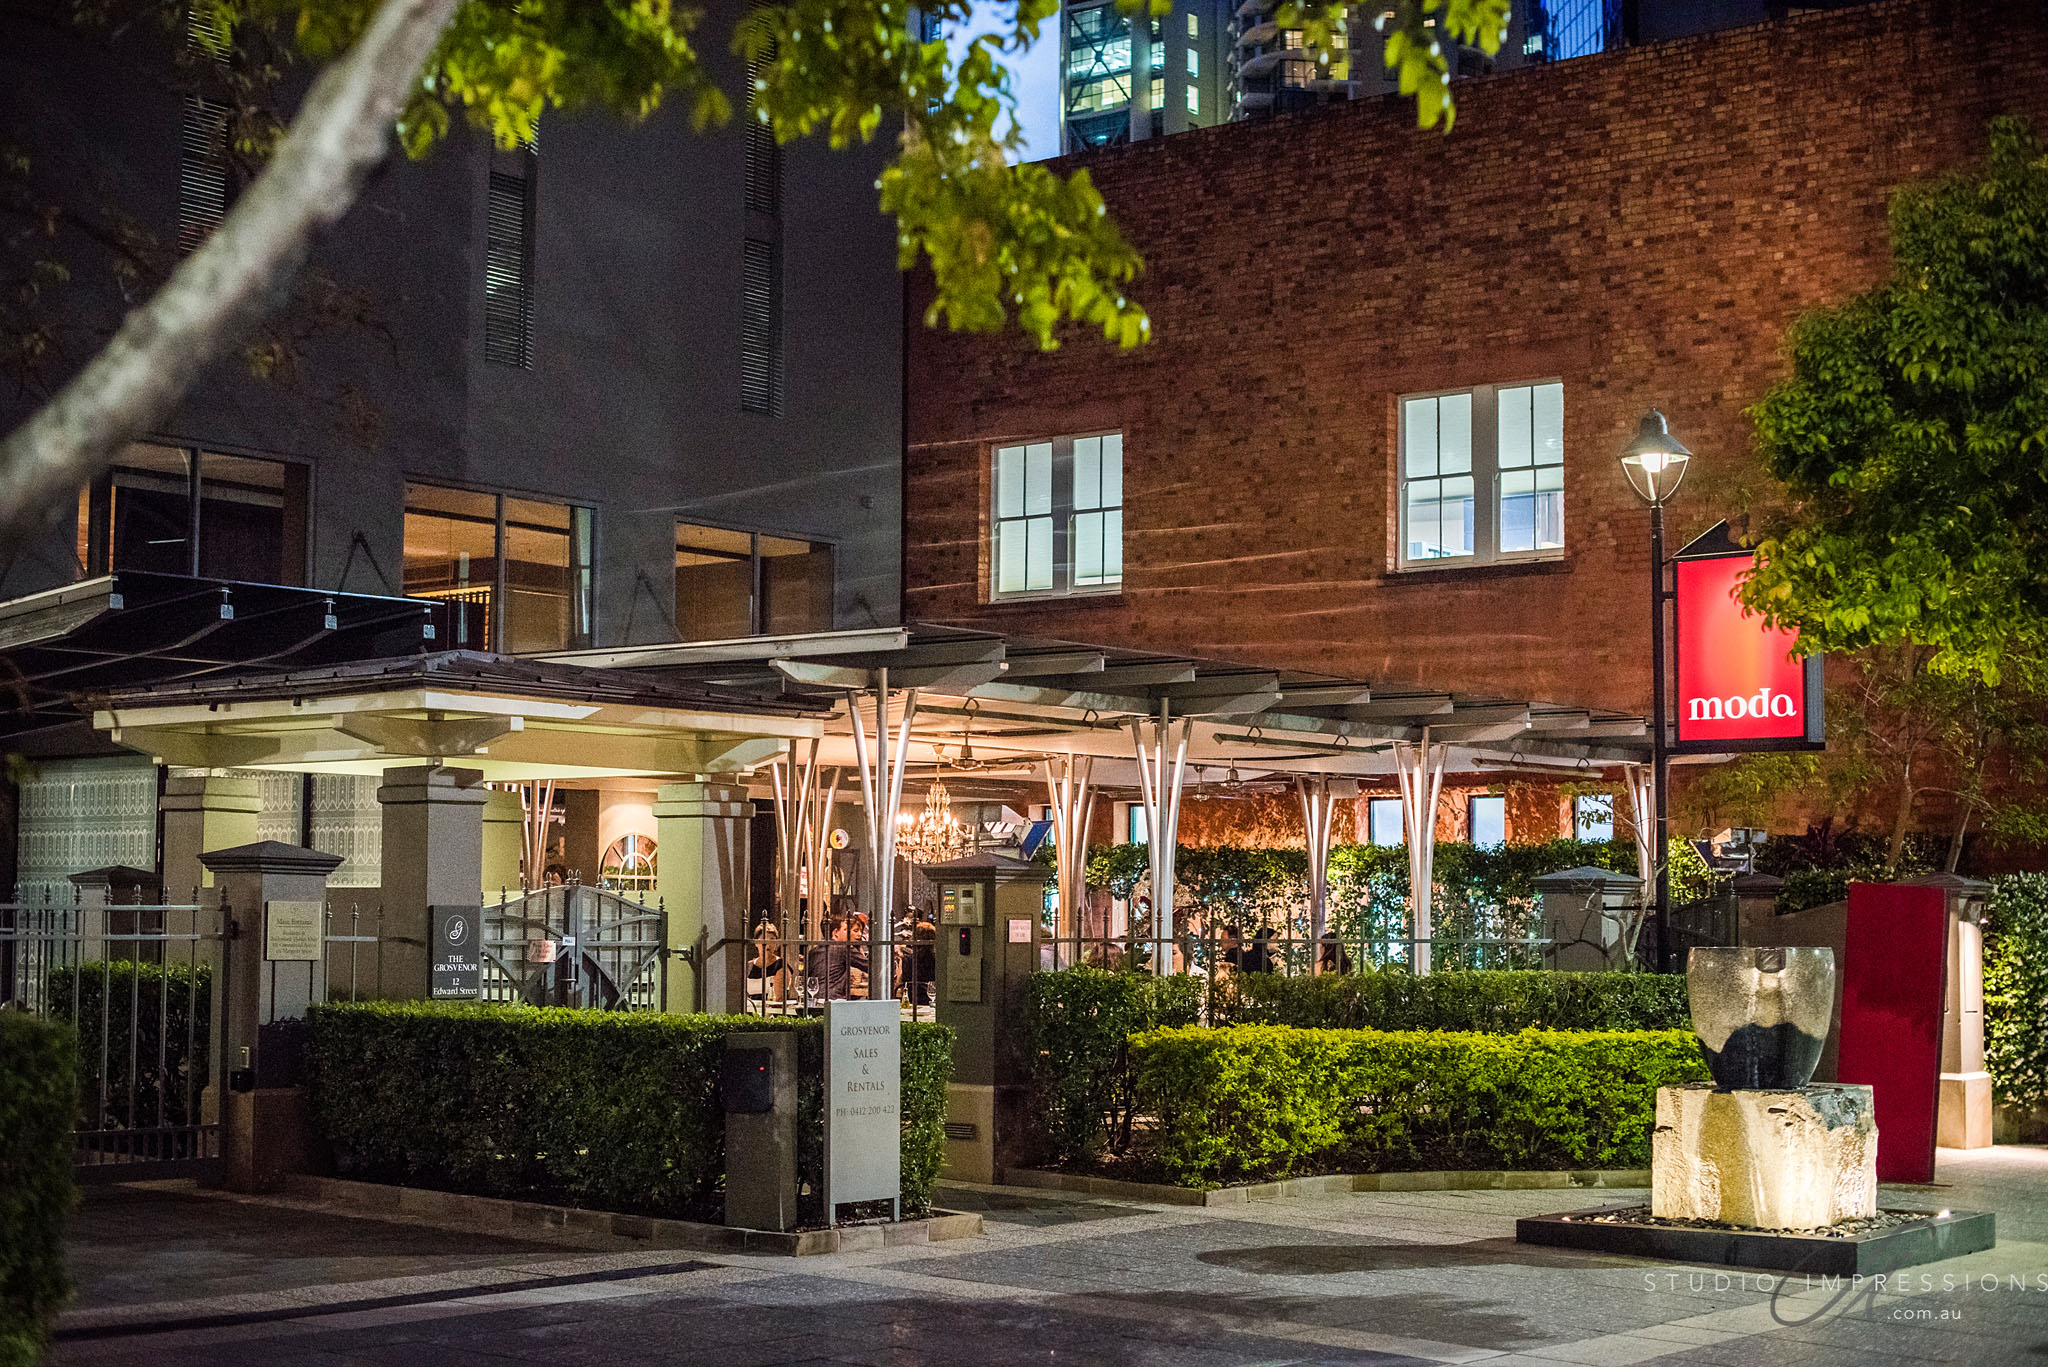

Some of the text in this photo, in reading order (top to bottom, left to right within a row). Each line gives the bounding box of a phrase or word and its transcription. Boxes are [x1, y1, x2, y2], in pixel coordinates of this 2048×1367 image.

[1688, 687, 1797, 720] moda
[447, 955, 464, 963] THE
[433, 963, 478, 972] GROSVENOR
[452, 977, 460, 986] 12
[433, 986, 478, 995] Edward Street
[840, 1025, 891, 1036] GROSVENOR
[861, 1063, 870, 1075] &
[850, 1106, 866, 1116] 0412
[868, 1105, 881, 1115] 200
